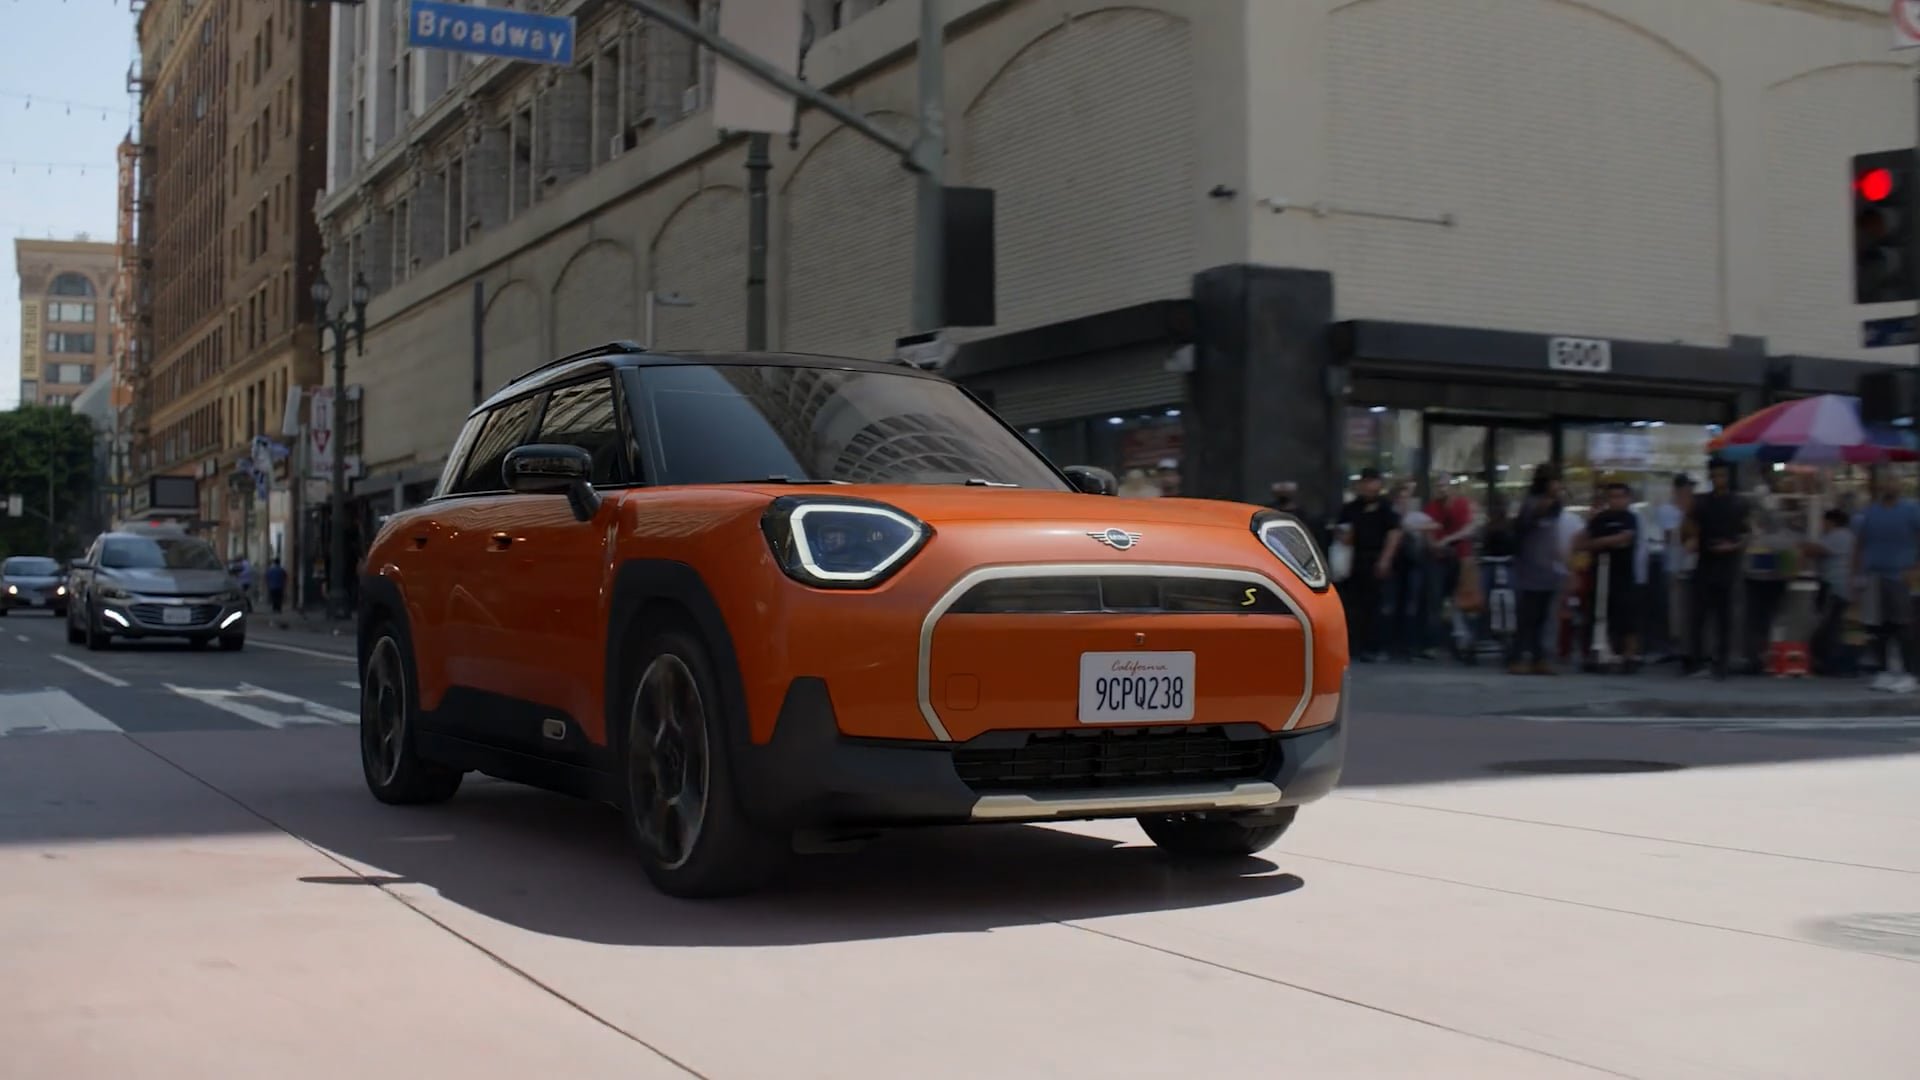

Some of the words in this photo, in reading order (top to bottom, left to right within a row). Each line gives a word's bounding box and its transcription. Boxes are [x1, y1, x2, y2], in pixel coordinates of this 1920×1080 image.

[417, 10, 566, 59] Broadway
[1240, 587, 1257, 606] S
[1111, 660, 1168, 677] California
[1096, 676, 1184, 711] 9CPQ238
